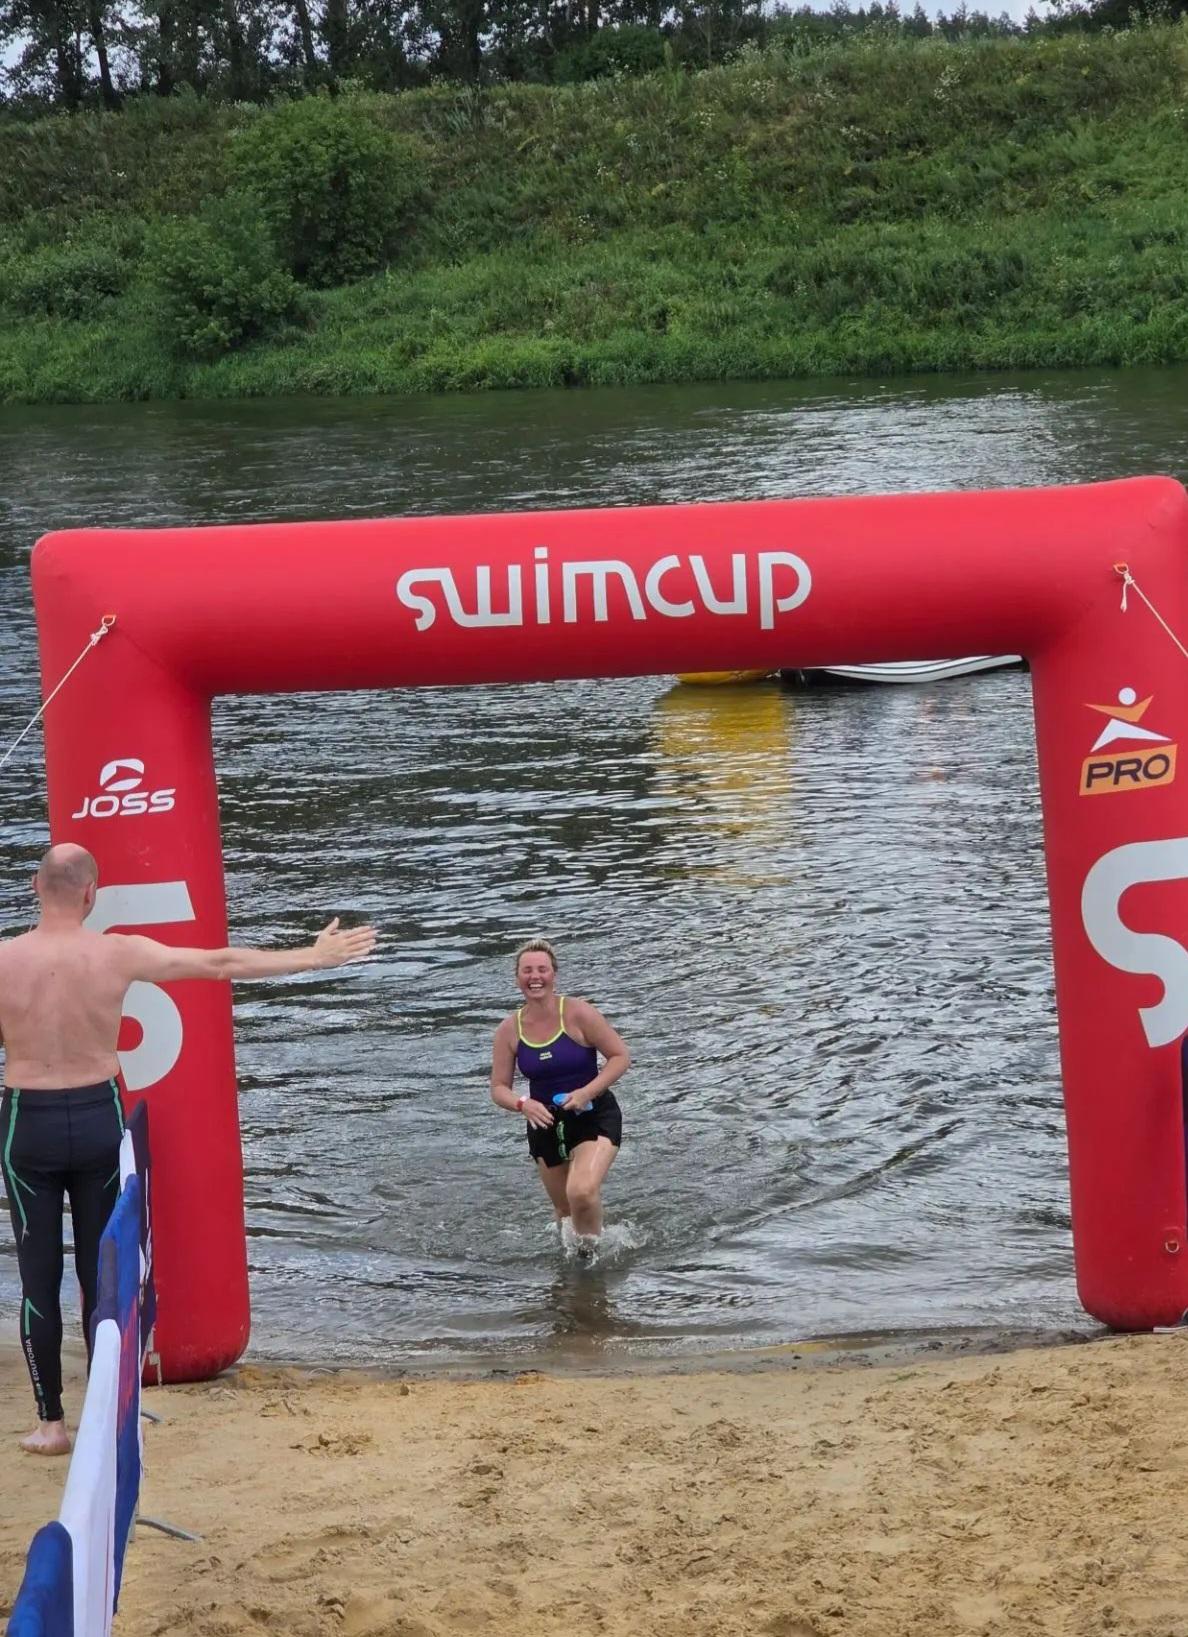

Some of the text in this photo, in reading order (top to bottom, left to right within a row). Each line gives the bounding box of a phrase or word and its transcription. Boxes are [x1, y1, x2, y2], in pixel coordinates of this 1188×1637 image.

[396, 546, 812, 632] swimcup
[1086, 754, 1170, 788] PRO
[71, 788, 176, 819] JOSS
